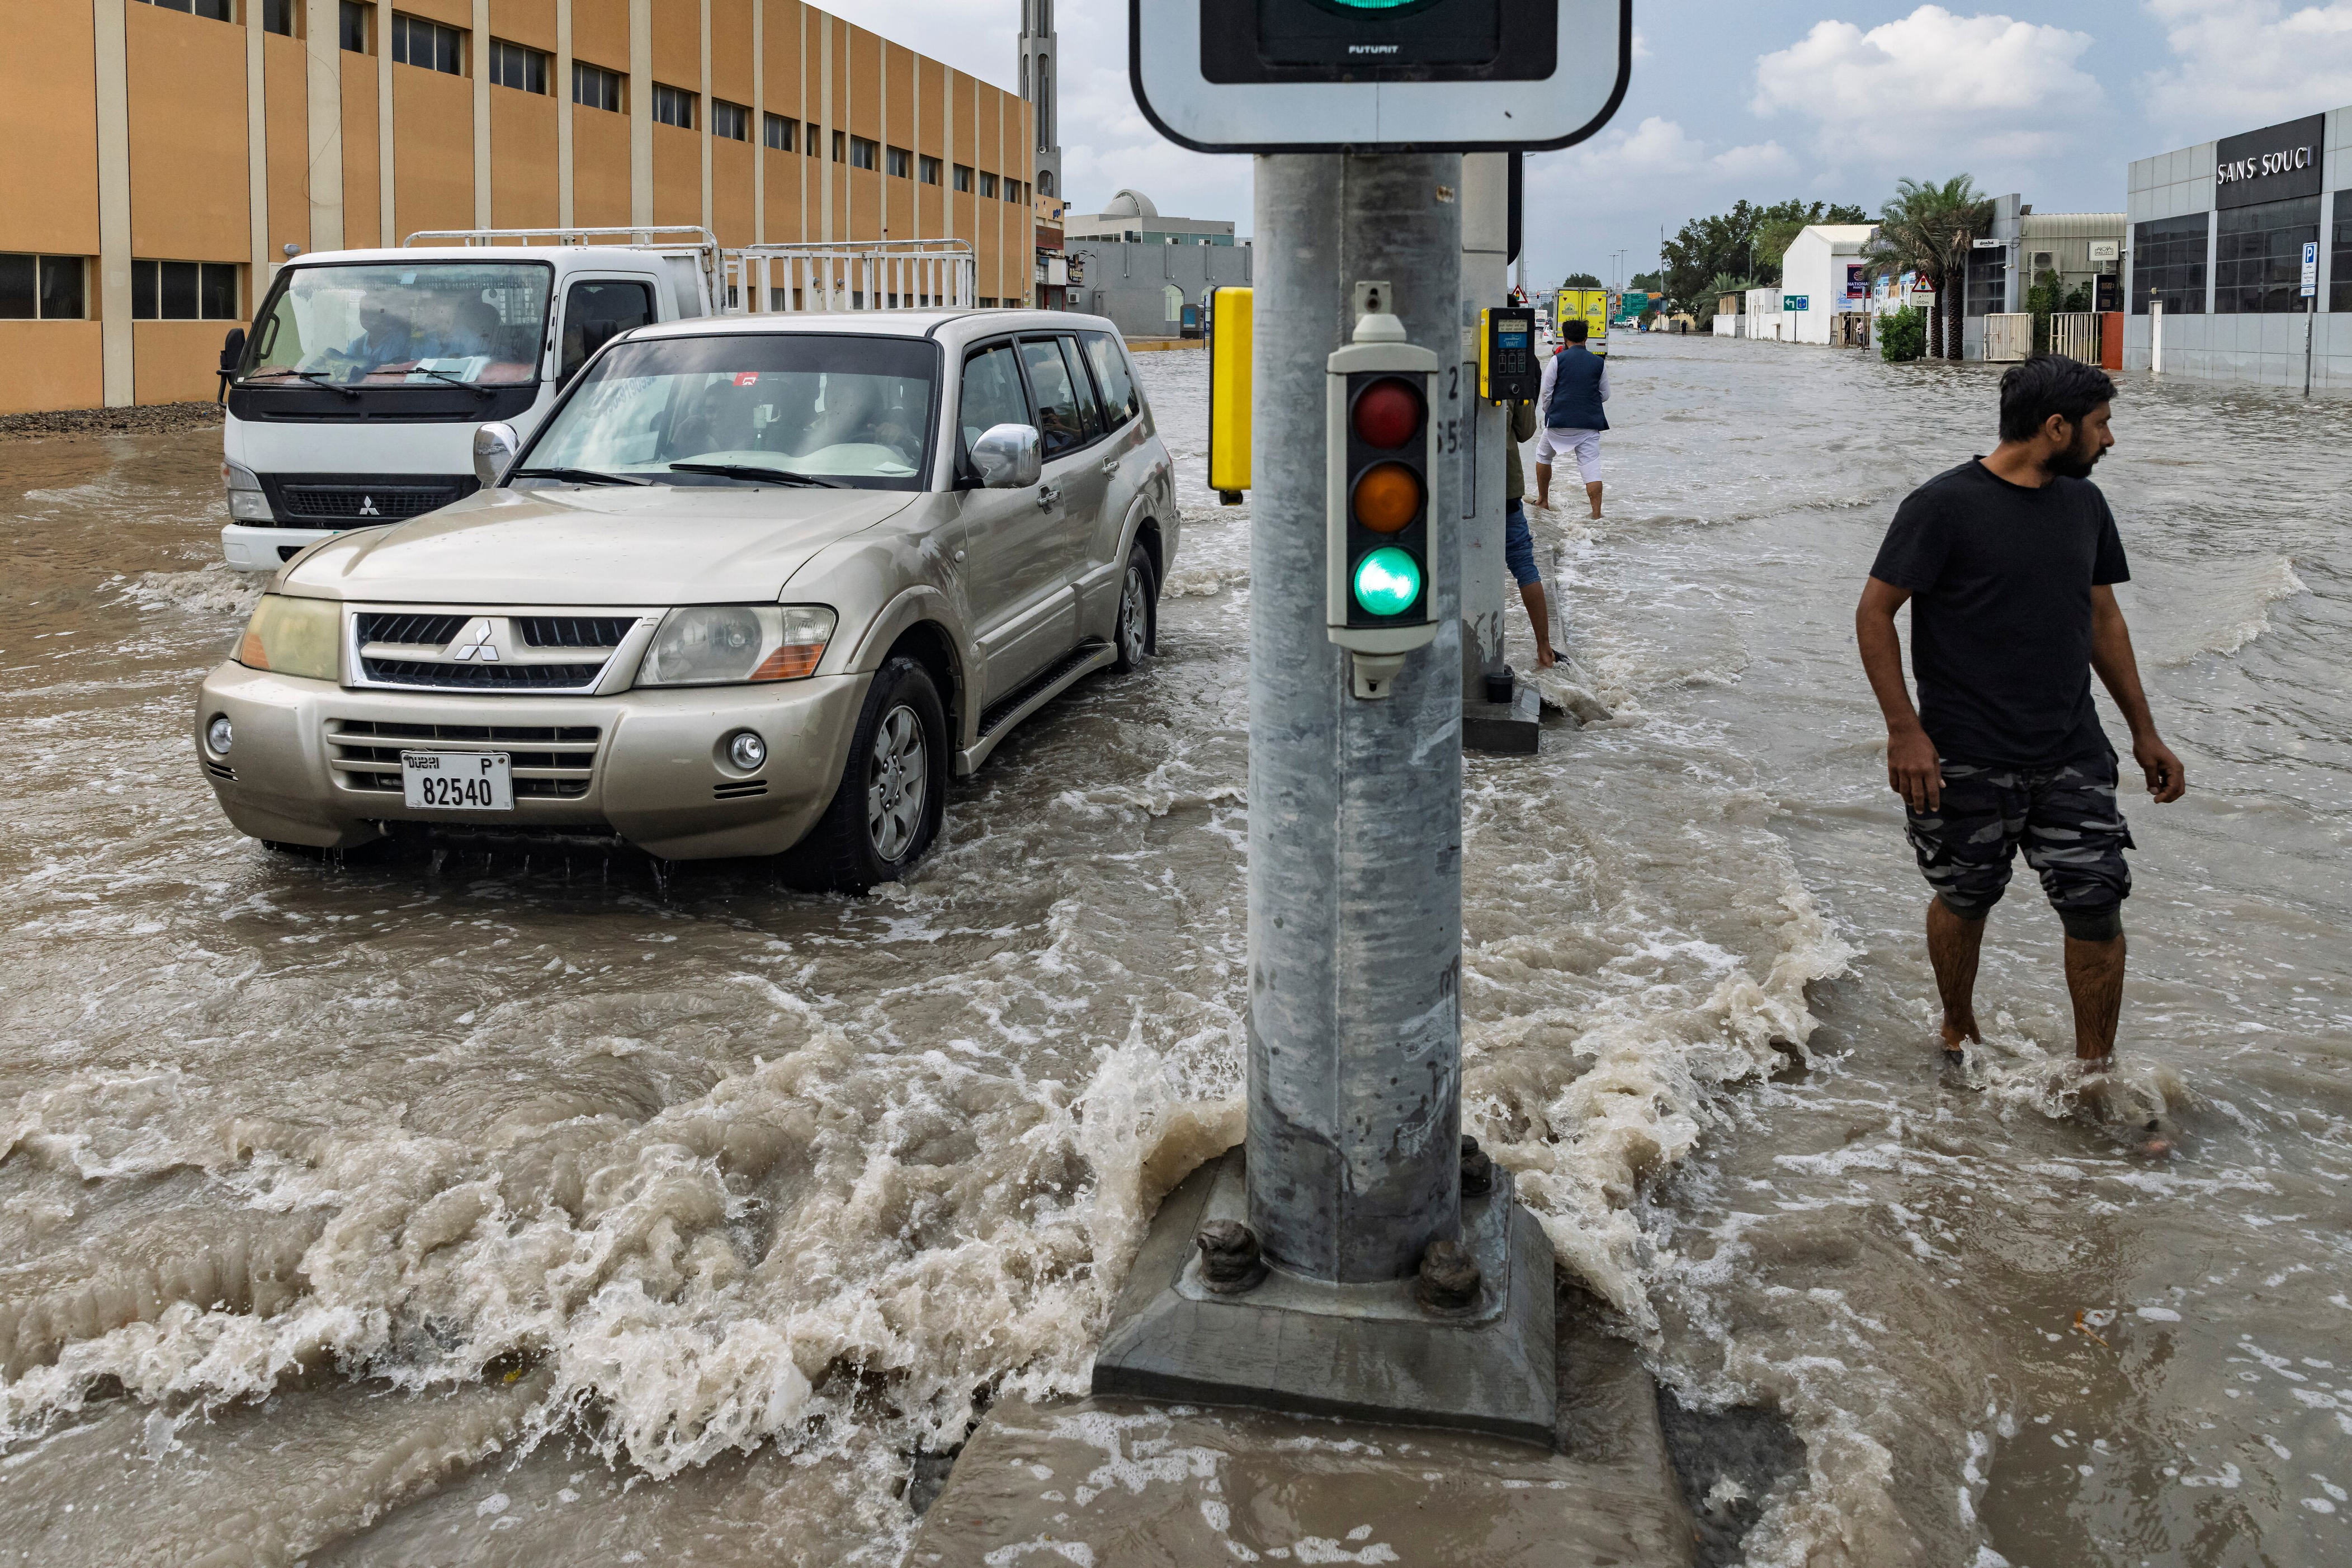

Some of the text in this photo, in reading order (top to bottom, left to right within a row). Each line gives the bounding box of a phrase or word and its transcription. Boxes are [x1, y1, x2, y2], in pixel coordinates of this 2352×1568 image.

[1348, 45, 1399, 54] FUTURIT
[2218, 145, 2313, 185] SANS SOUCI
[2307, 246, 2313, 262] P
[1448, 366, 1458, 400] 2
[409, 756, 493, 775] DUBAI P
[423, 777, 492, 806] 82540
